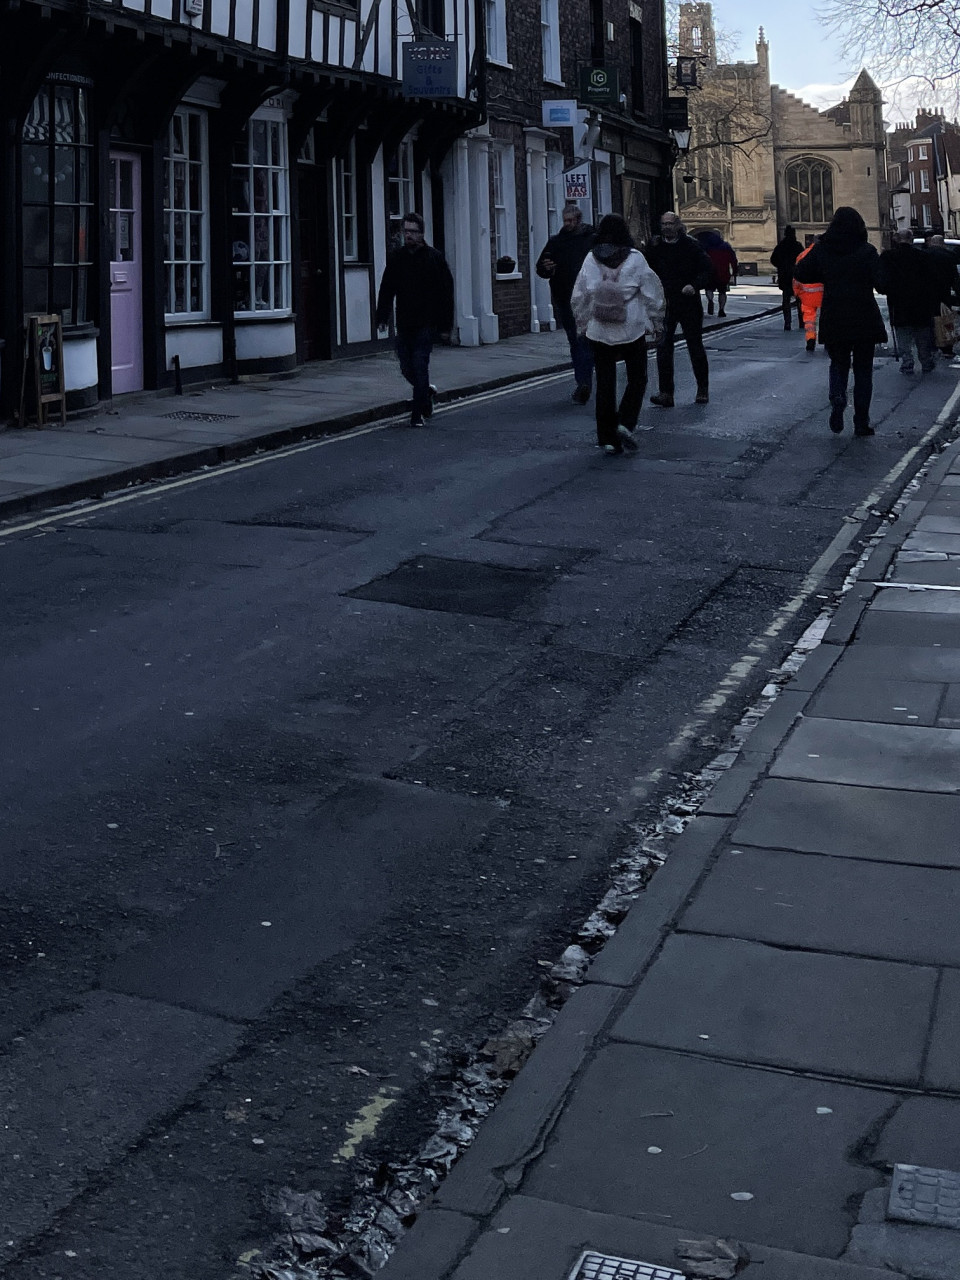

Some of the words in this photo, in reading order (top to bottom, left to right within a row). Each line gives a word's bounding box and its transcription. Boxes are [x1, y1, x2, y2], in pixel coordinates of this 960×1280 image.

[416, 64, 442, 74] Gifts
[426, 76, 432, 85] &
[594, 74, 604, 82] IG
[408, 86, 451, 95] Souvenirs
[565, 173, 587, 183] LEFT
